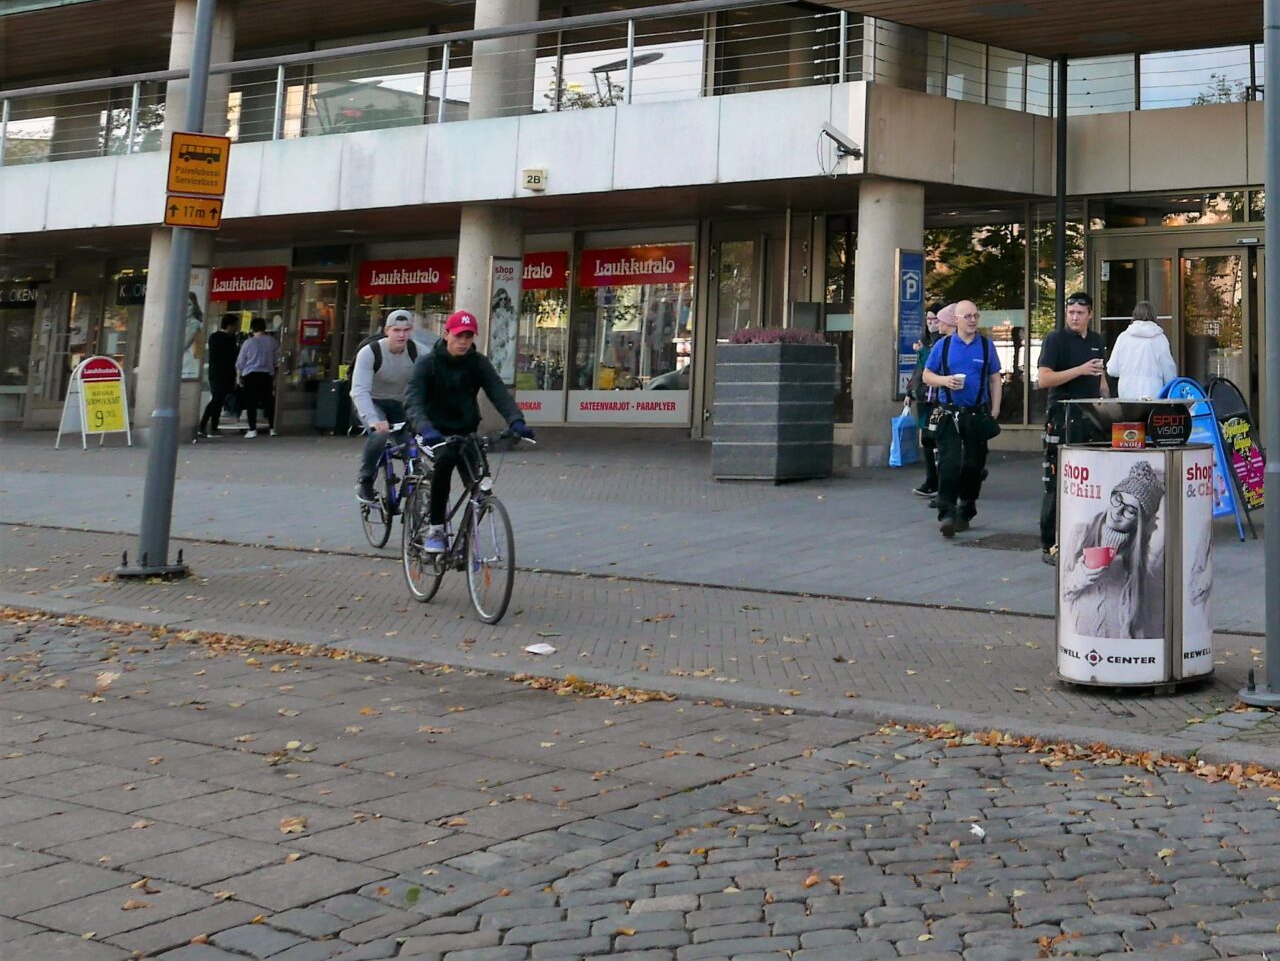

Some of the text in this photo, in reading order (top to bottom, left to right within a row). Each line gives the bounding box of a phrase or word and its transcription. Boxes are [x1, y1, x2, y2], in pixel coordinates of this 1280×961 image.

[527, 175, 541, 184] 2B
[495, 266, 514, 274] shop
[593, 256, 676, 277] Laukkutalo
[211, 275, 274, 293] Laukkutalo
[370, 267, 441, 286] Laukkutalo
[580, 401, 630, 411] SATEENVARJOT
[636, 401, 676, 411] PARAPLYER
[1153, 415, 1185, 426] SPOT
[1157, 426, 1184, 435] VISION
[1063, 461, 1089, 485] shop
[1186, 462, 1213, 483] shop
[1069, 482, 1102, 499] Chill
[1186, 486, 1196, 498] &
[1060, 646, 1156, 664] EWELL CENTER
